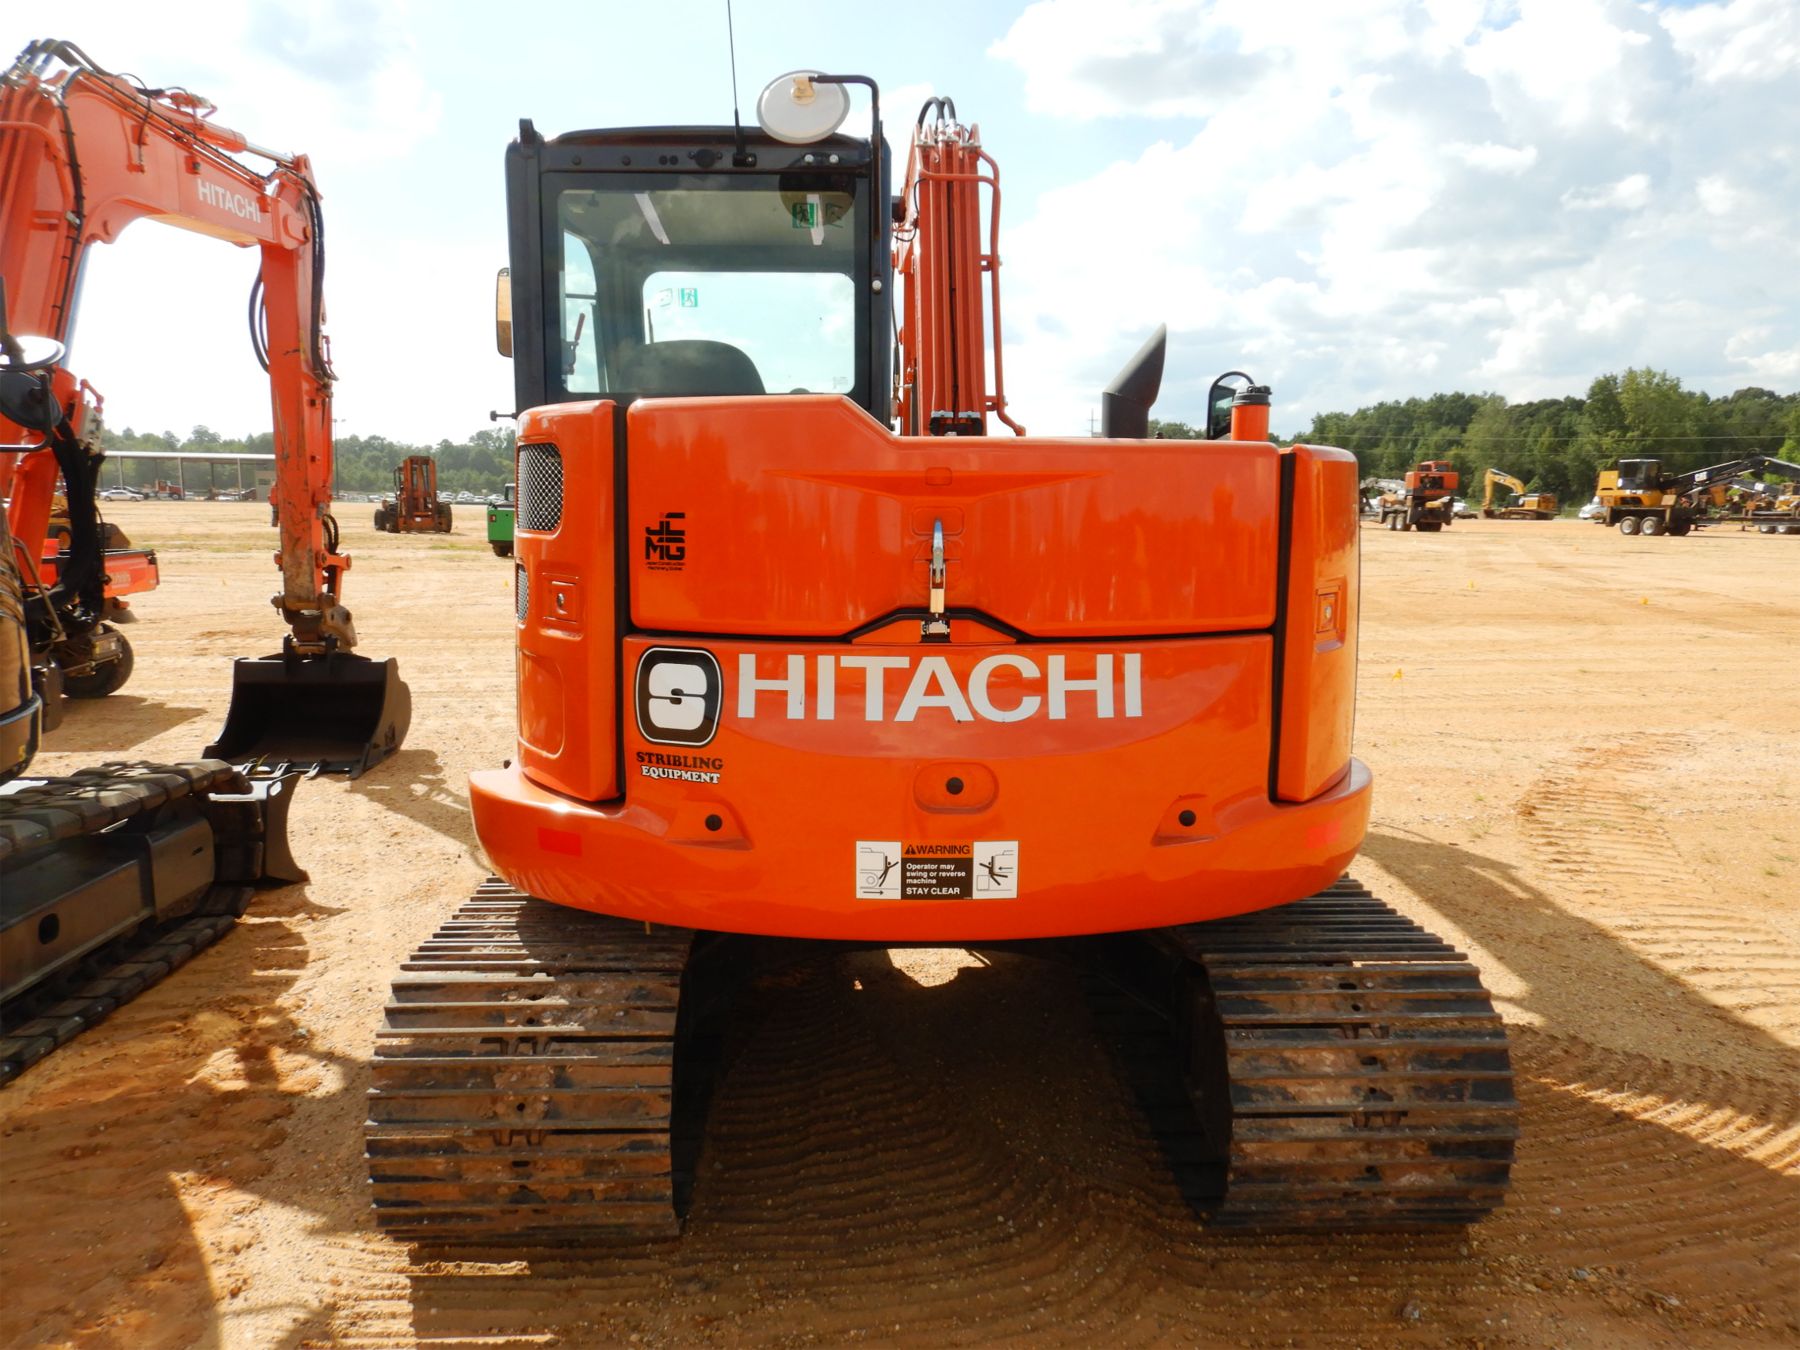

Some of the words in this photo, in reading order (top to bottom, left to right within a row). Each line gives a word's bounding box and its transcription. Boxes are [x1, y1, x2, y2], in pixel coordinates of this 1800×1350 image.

[197, 178, 261, 223] HITACHI
[737, 653, 1142, 721] HITACHI
[636, 752, 724, 770] STRIBLING
[641, 765, 720, 784] EQUIPMENT
[916, 844, 970, 855] WARNING
[906, 887, 929, 895] STAY
[930, 887, 960, 895] CLEAR
